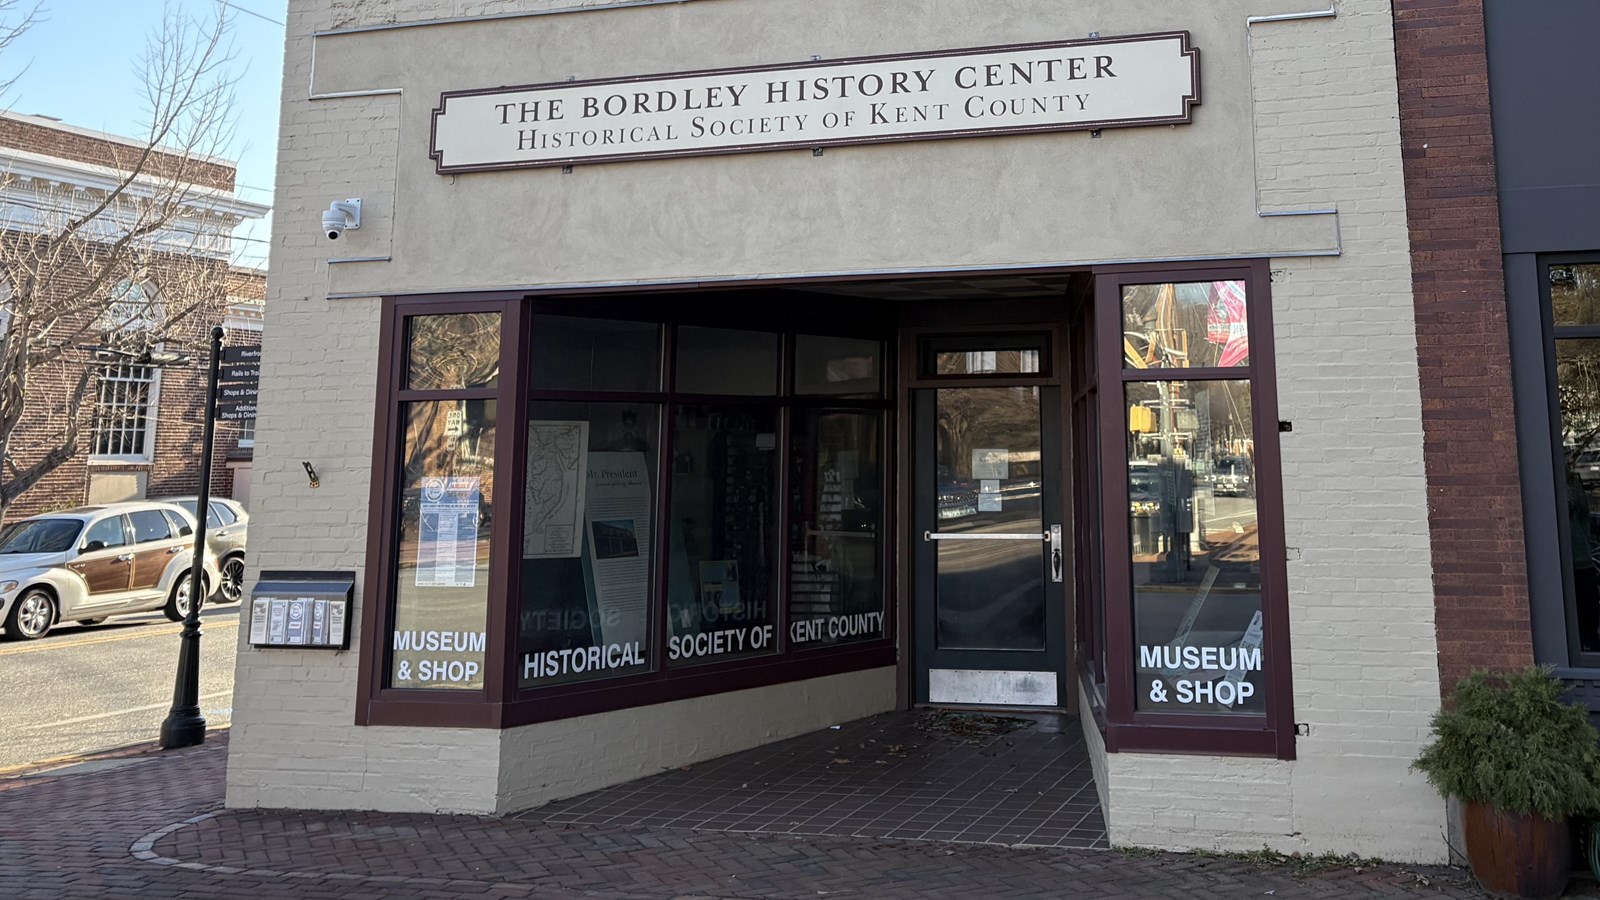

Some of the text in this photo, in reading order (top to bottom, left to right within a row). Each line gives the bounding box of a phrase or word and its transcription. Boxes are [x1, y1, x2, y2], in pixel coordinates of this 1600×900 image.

[495, 55, 1118, 125] THE BORDLEY HISTORY CENTER
[516, 93, 1090, 150] HISTORICAL SOCIETY OF KENT COUNTY
[223, 389, 240, 397] Shops
[601, 468, 638, 479] President
[828, 610, 885, 638] COUNTY
[393, 630, 486, 652] MUSEUM
[668, 625, 773, 660] SOCIETY OF
[397, 660, 479, 682] & SHOP
[523, 641, 645, 679] HISTORICAL
[1140, 645, 1262, 671] MUSEUM
[1149, 679, 1255, 705] & SHOP
